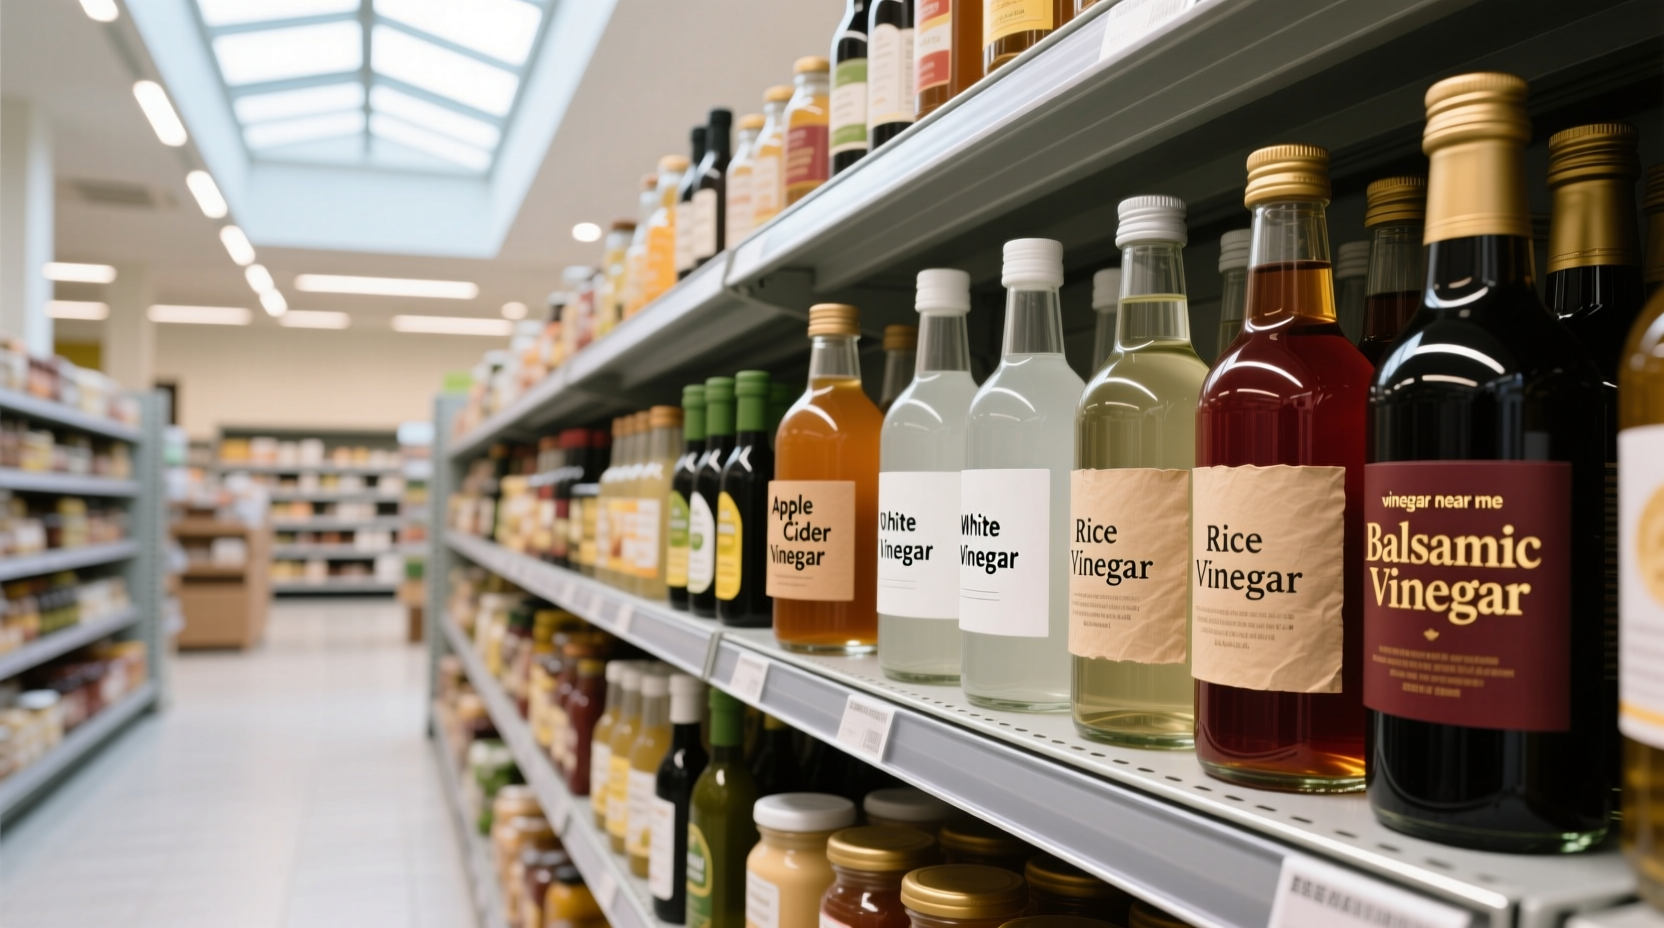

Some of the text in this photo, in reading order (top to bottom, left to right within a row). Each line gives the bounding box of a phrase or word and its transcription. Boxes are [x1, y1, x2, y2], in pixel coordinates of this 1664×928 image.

[772, 494, 814, 521] Apple
[1382, 490, 1503, 513] vinegar near me
[784, 521, 832, 542] Cider
[1075, 518, 1118, 544] Rice
[1206, 524, 1263, 554] Rice
[1366, 520, 1542, 569] Balsamic
[771, 544, 826, 571] Vinegar
[960, 544, 1019, 575] Vinegar
[1071, 549, 1154, 586] Vinegar
[1196, 559, 1303, 601] Vinegar
[1370, 566, 1531, 625] Vinegar
